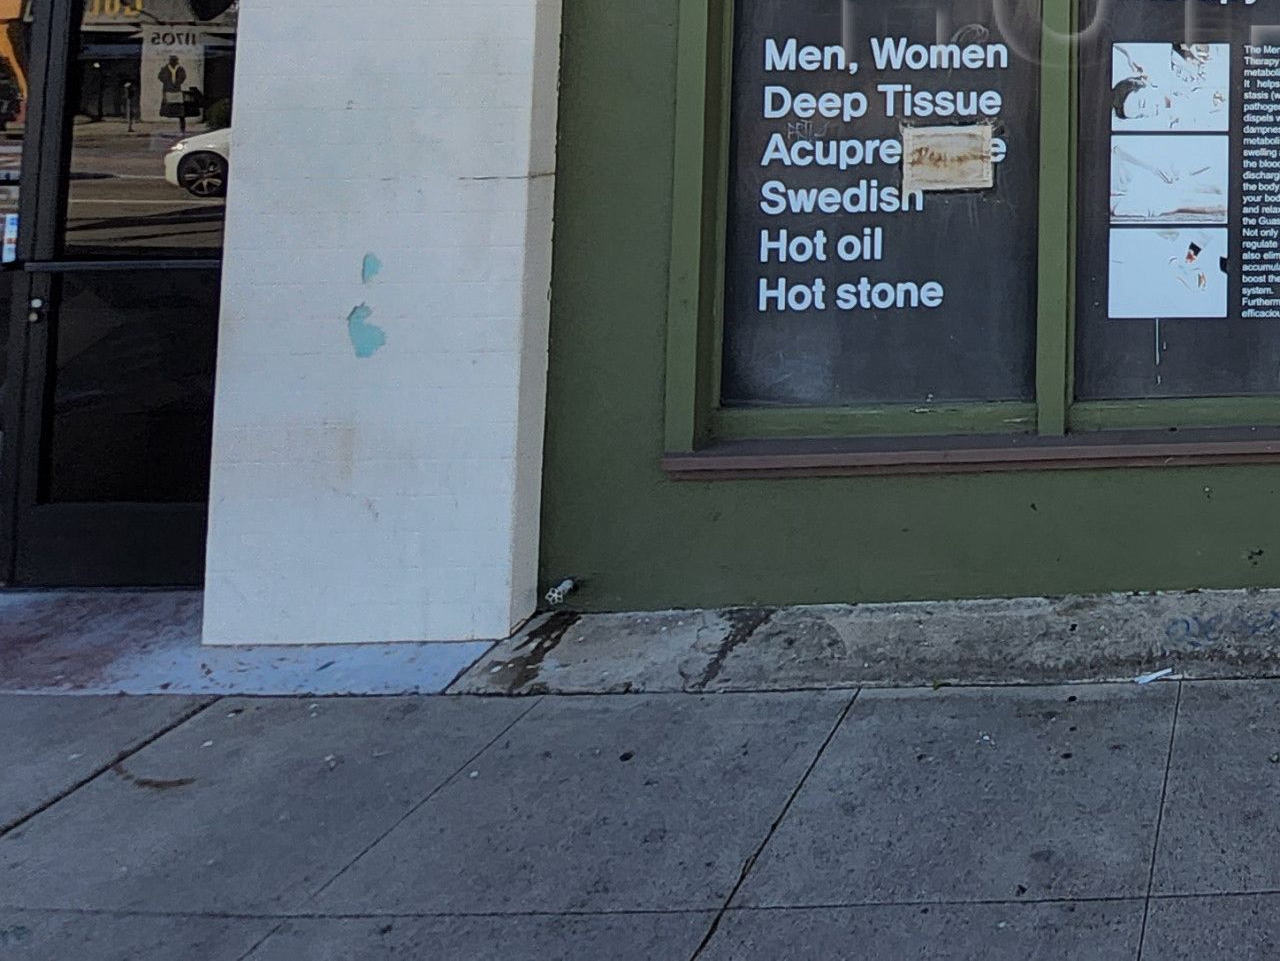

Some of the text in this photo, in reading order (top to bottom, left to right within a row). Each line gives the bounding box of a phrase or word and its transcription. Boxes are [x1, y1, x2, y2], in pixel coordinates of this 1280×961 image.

[1244, 45, 1261, 54] The
[765, 37, 1009, 75] Men, Women
[1244, 57, 1279, 67] Therapy
[1244, 80, 1250, 88] It
[1257, 80, 1280, 90] helps
[1244, 91, 1268, 99] stasis
[764, 84, 1002, 122] Deep Tissue
[1244, 114, 1274, 124] dispels
[760, 133, 1007, 170] Acupree
[1243, 148, 1277, 158] swelling
[1243, 159, 1257, 168] the
[1243, 182, 1257, 191] the
[1243, 196, 1262, 204] your
[1243, 205, 1259, 213] and
[1242, 216, 1255, 225] the
[1243, 228, 1258, 236] Not
[1261, 228, 1278, 238] only
[760, 227, 883, 262] Hot oil
[1243, 239, 1278, 249] regulate
[1242, 251, 1261, 259] also
[1242, 274, 1266, 283] boost
[758, 277, 944, 311] Hot stone
